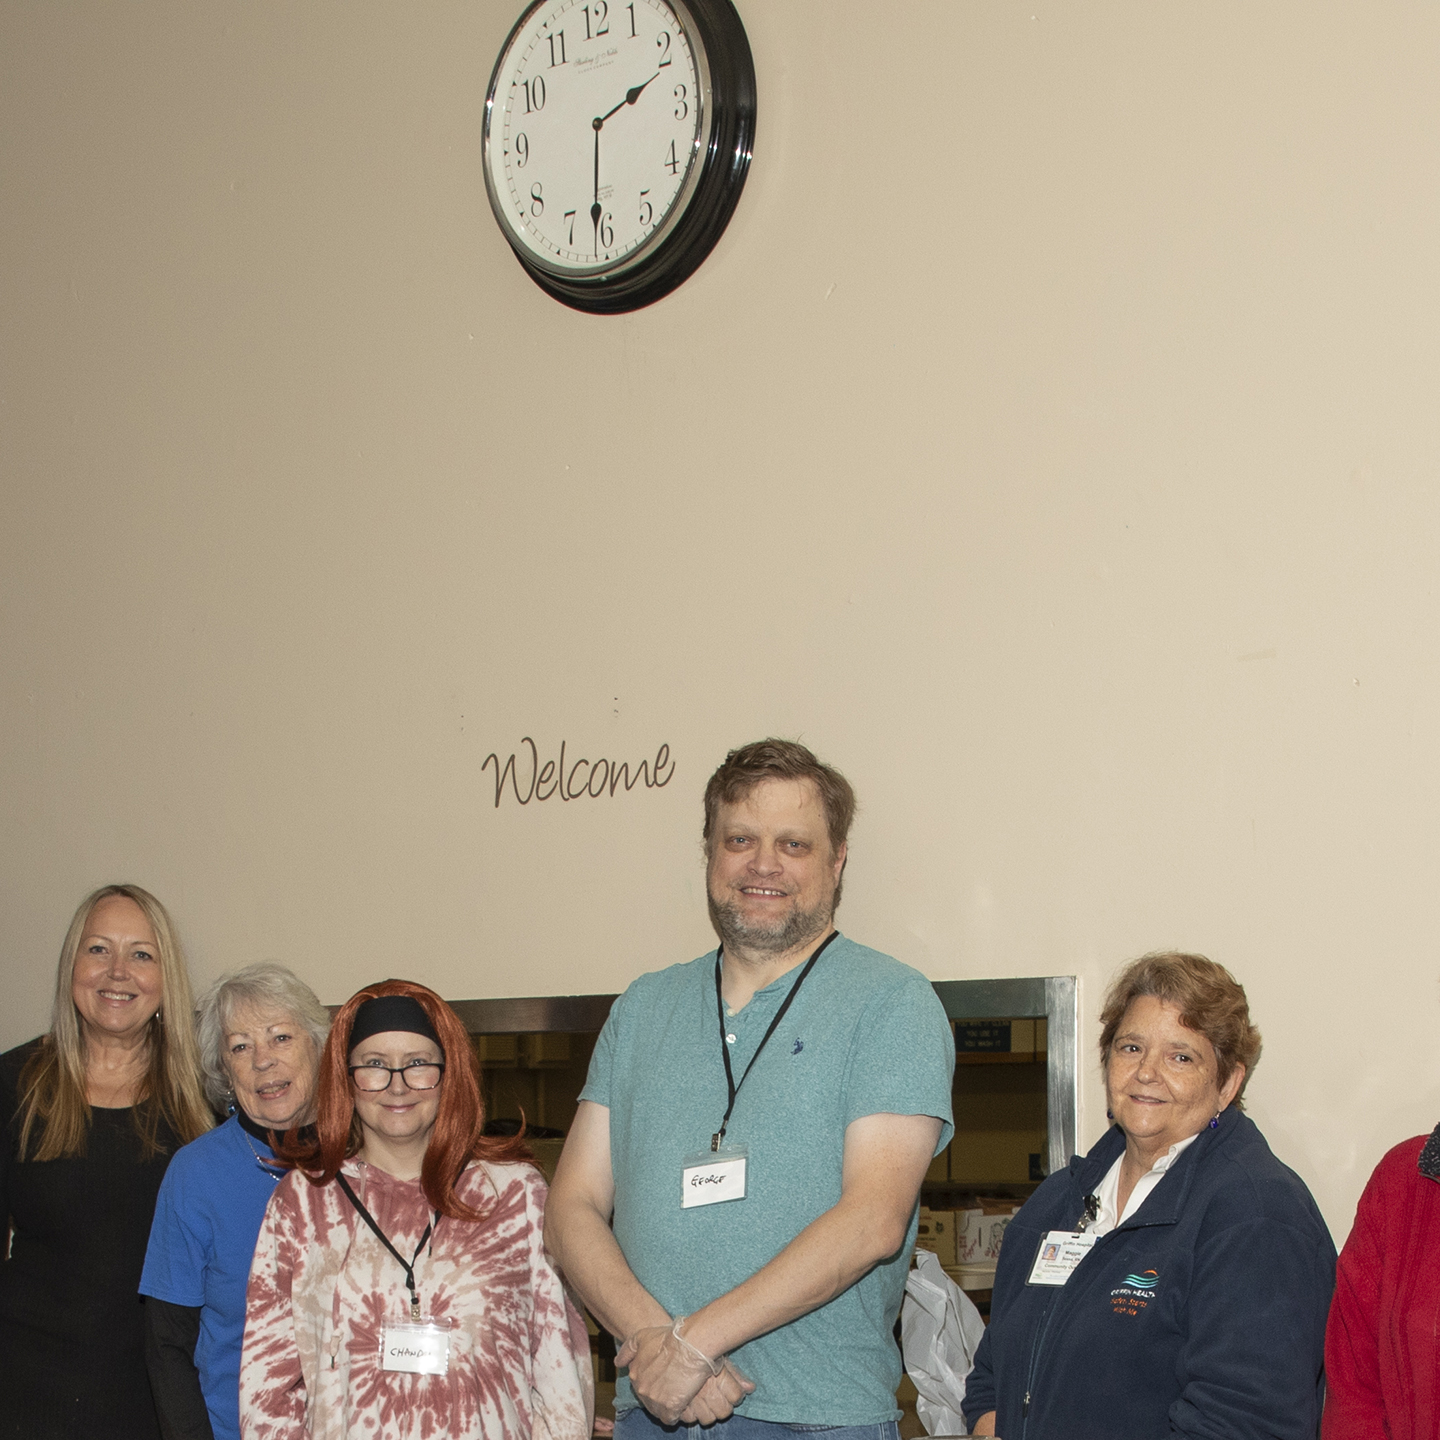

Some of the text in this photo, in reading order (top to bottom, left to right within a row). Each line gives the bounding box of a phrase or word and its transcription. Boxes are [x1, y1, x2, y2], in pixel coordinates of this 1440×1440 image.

[581, 1, 609, 41] 12
[626, 2, 640, 39] 1
[546, 29, 570, 69] 11
[657, 31, 672, 69] 2
[521, 75, 546, 115] 10
[674, 84, 688, 120] 3
[515, 132, 529, 168] 9
[664, 139, 680, 176] 4
[530, 181, 544, 217] 8
[639, 189, 653, 226] 5
[563, 210, 576, 245] 7
[600, 212, 614, 248] 6
[481, 736, 676, 808] Welcome
[691, 1175, 726, 1187] GEORGE
